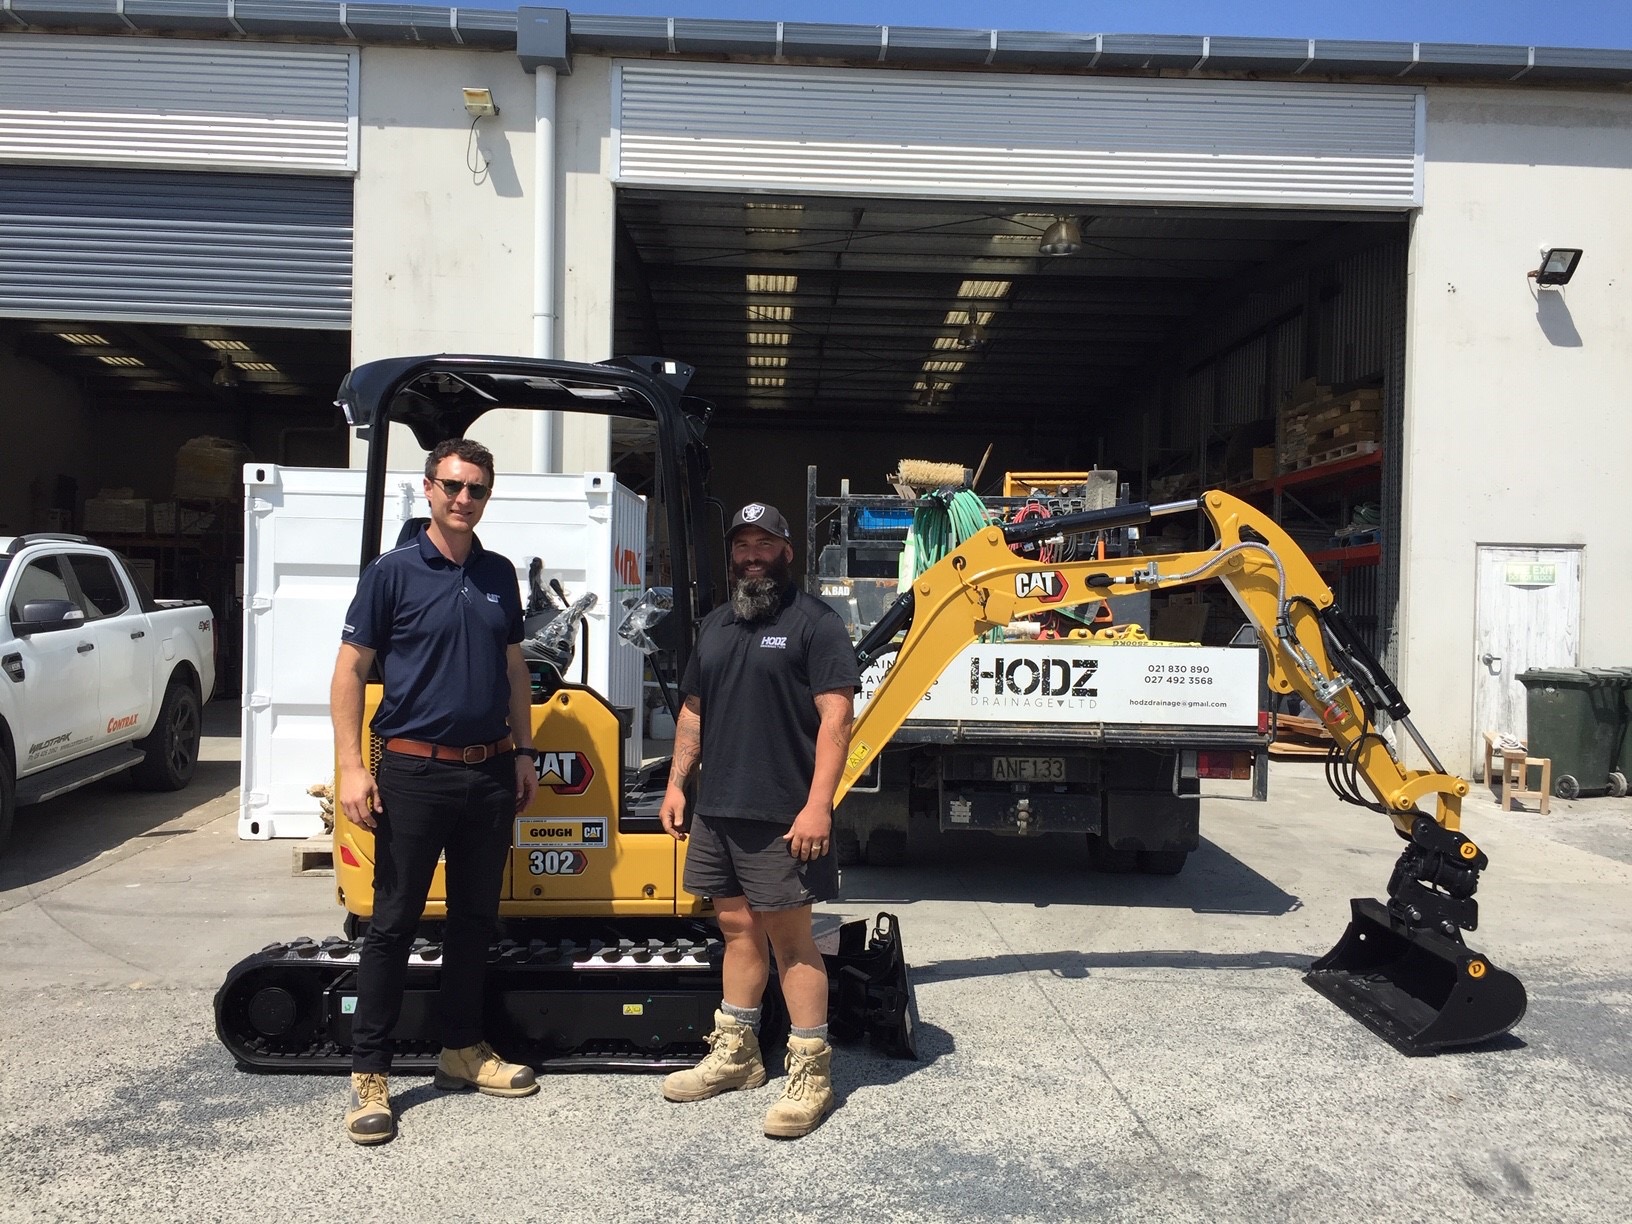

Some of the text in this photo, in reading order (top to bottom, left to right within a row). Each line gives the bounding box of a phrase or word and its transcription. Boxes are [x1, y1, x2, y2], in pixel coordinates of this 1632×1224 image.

[1532, 565, 1555, 575] EXIT
[1015, 571, 1055, 598] CAT
[761, 636, 787, 646] HODZ
[1148, 664, 1210, 674] 021 830 890
[970, 657, 1098, 697] HODZ
[1144, 675, 1213, 685] 027 492 3568
[970, 696, 1097, 709] DRAINAGE LTD
[530, 827, 602, 838] GOUGH CAT
[529, 850, 574, 875] 302
